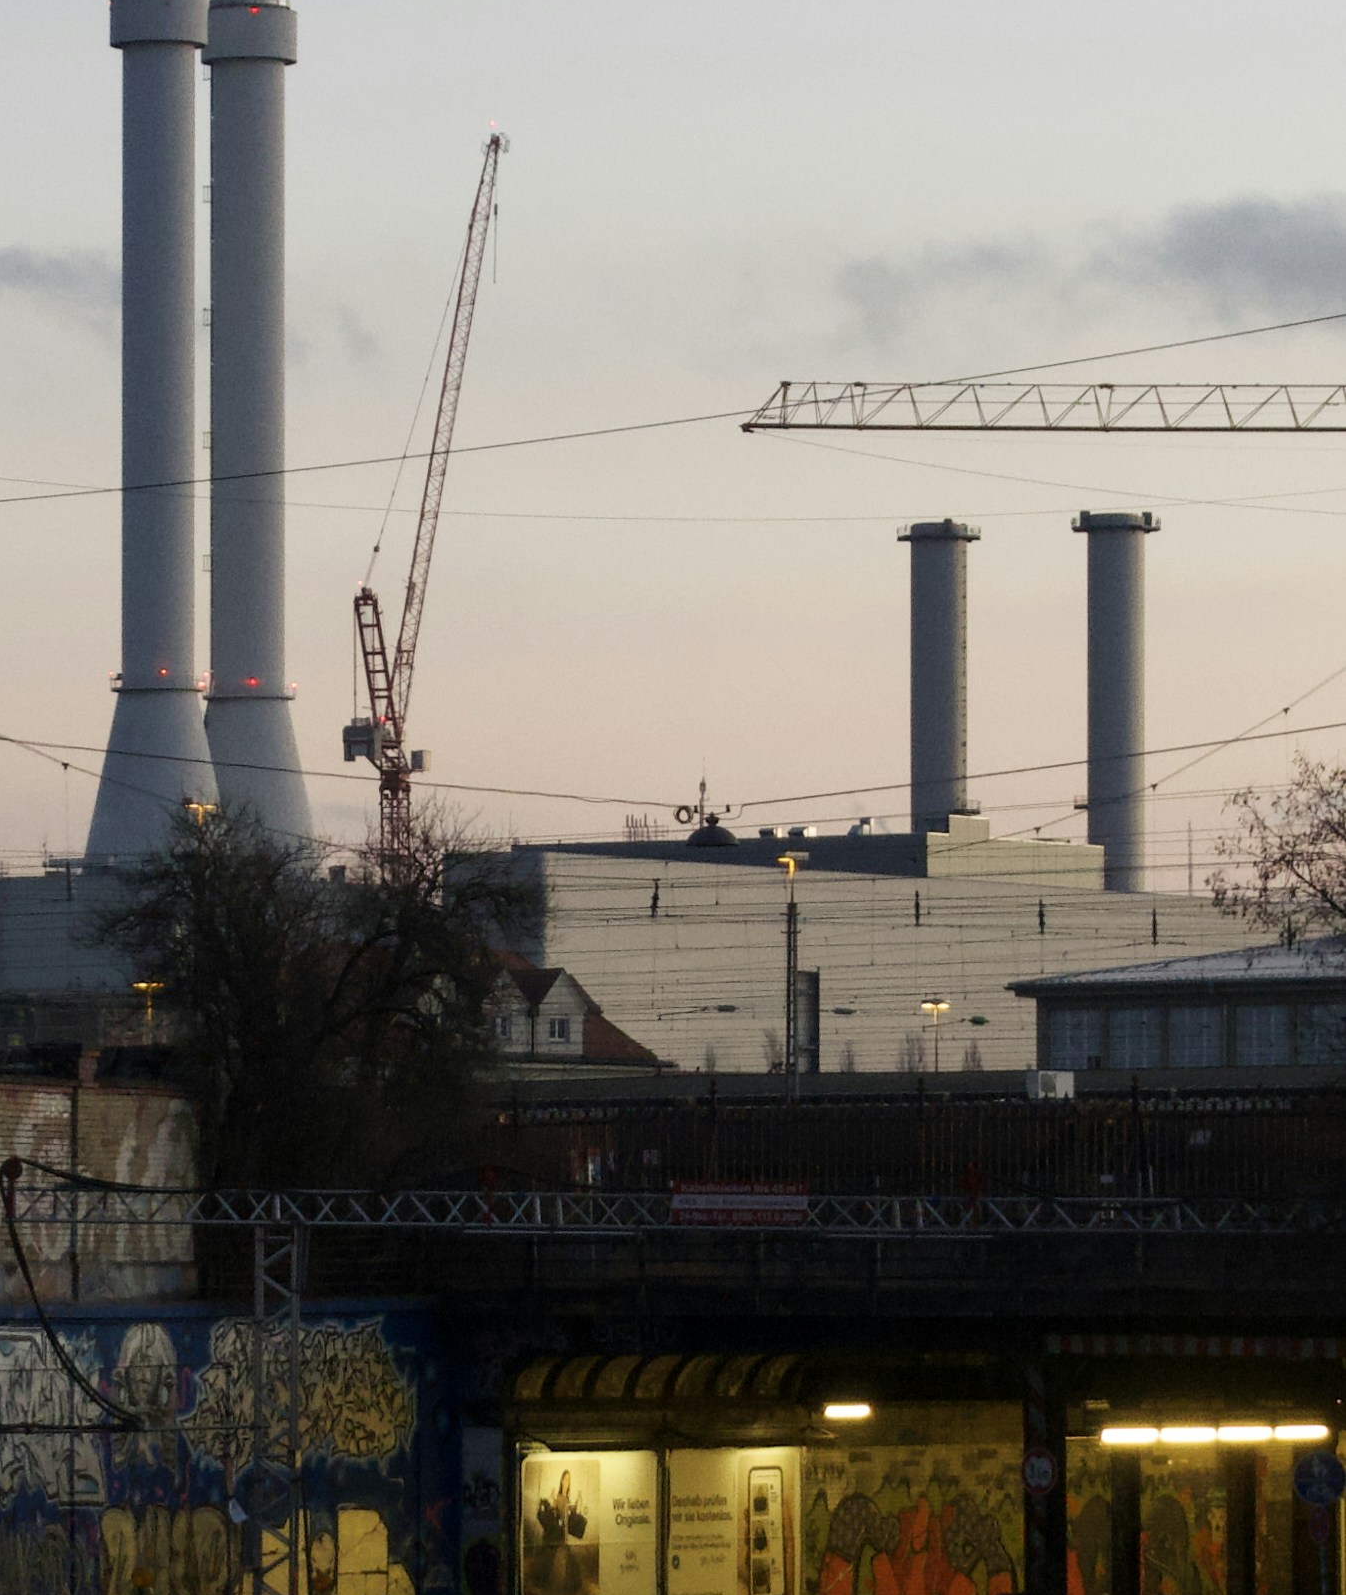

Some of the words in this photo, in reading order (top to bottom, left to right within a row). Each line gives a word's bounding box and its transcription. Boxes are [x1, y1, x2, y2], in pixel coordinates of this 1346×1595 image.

[612, 1498, 626, 1510] Wir
[628, 1497, 650, 1509] lieben
[671, 1494, 703, 1507] Deshalb
[703, 1493, 728, 1508] prüfen
